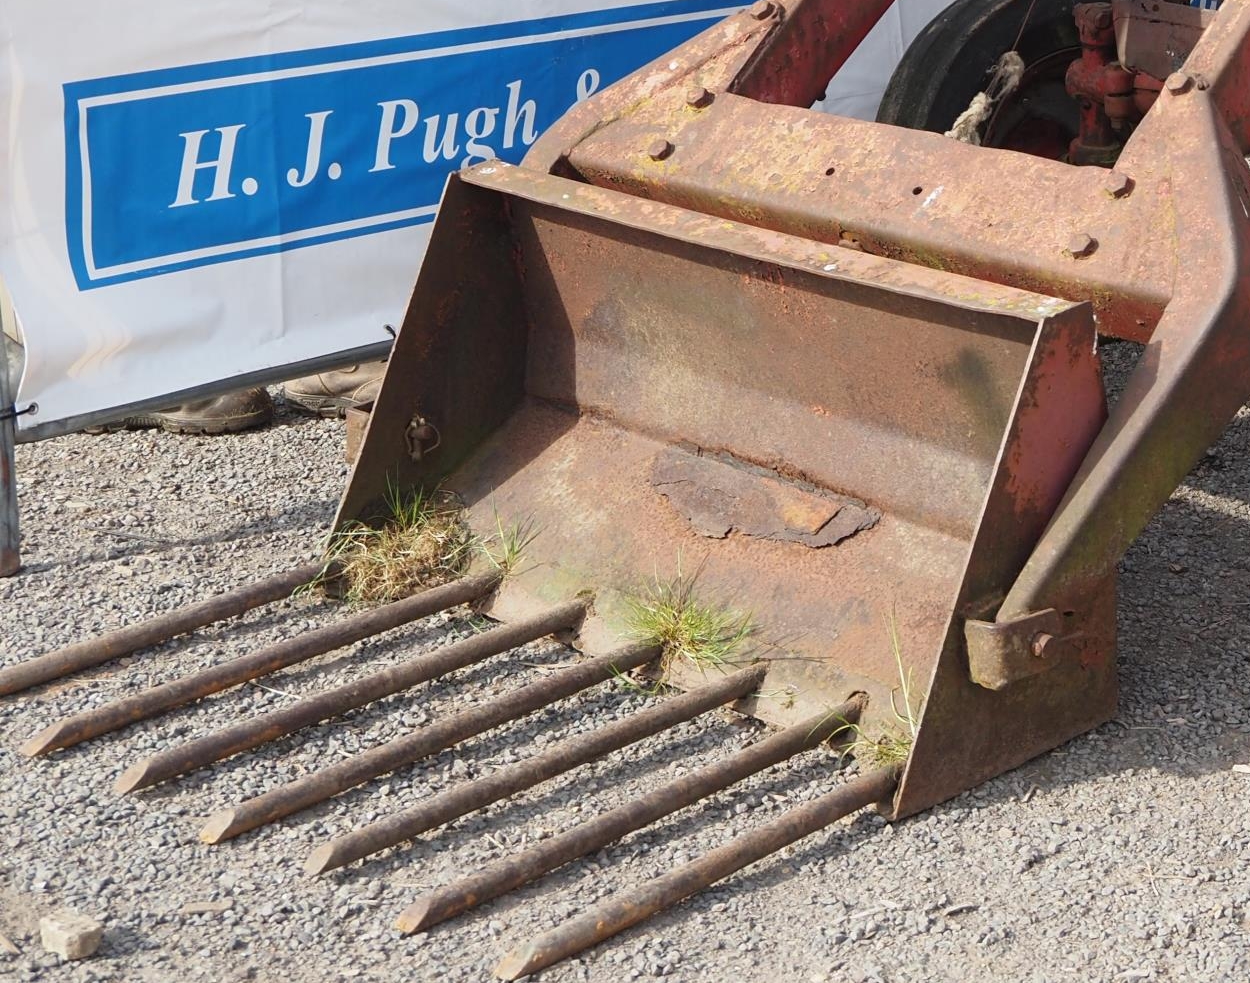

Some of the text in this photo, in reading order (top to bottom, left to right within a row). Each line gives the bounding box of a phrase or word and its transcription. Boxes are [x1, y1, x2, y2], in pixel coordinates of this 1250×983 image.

[168, 124, 258, 208] H.
[287, 110, 342, 187] J.
[368, 79, 538, 173] Pugh
